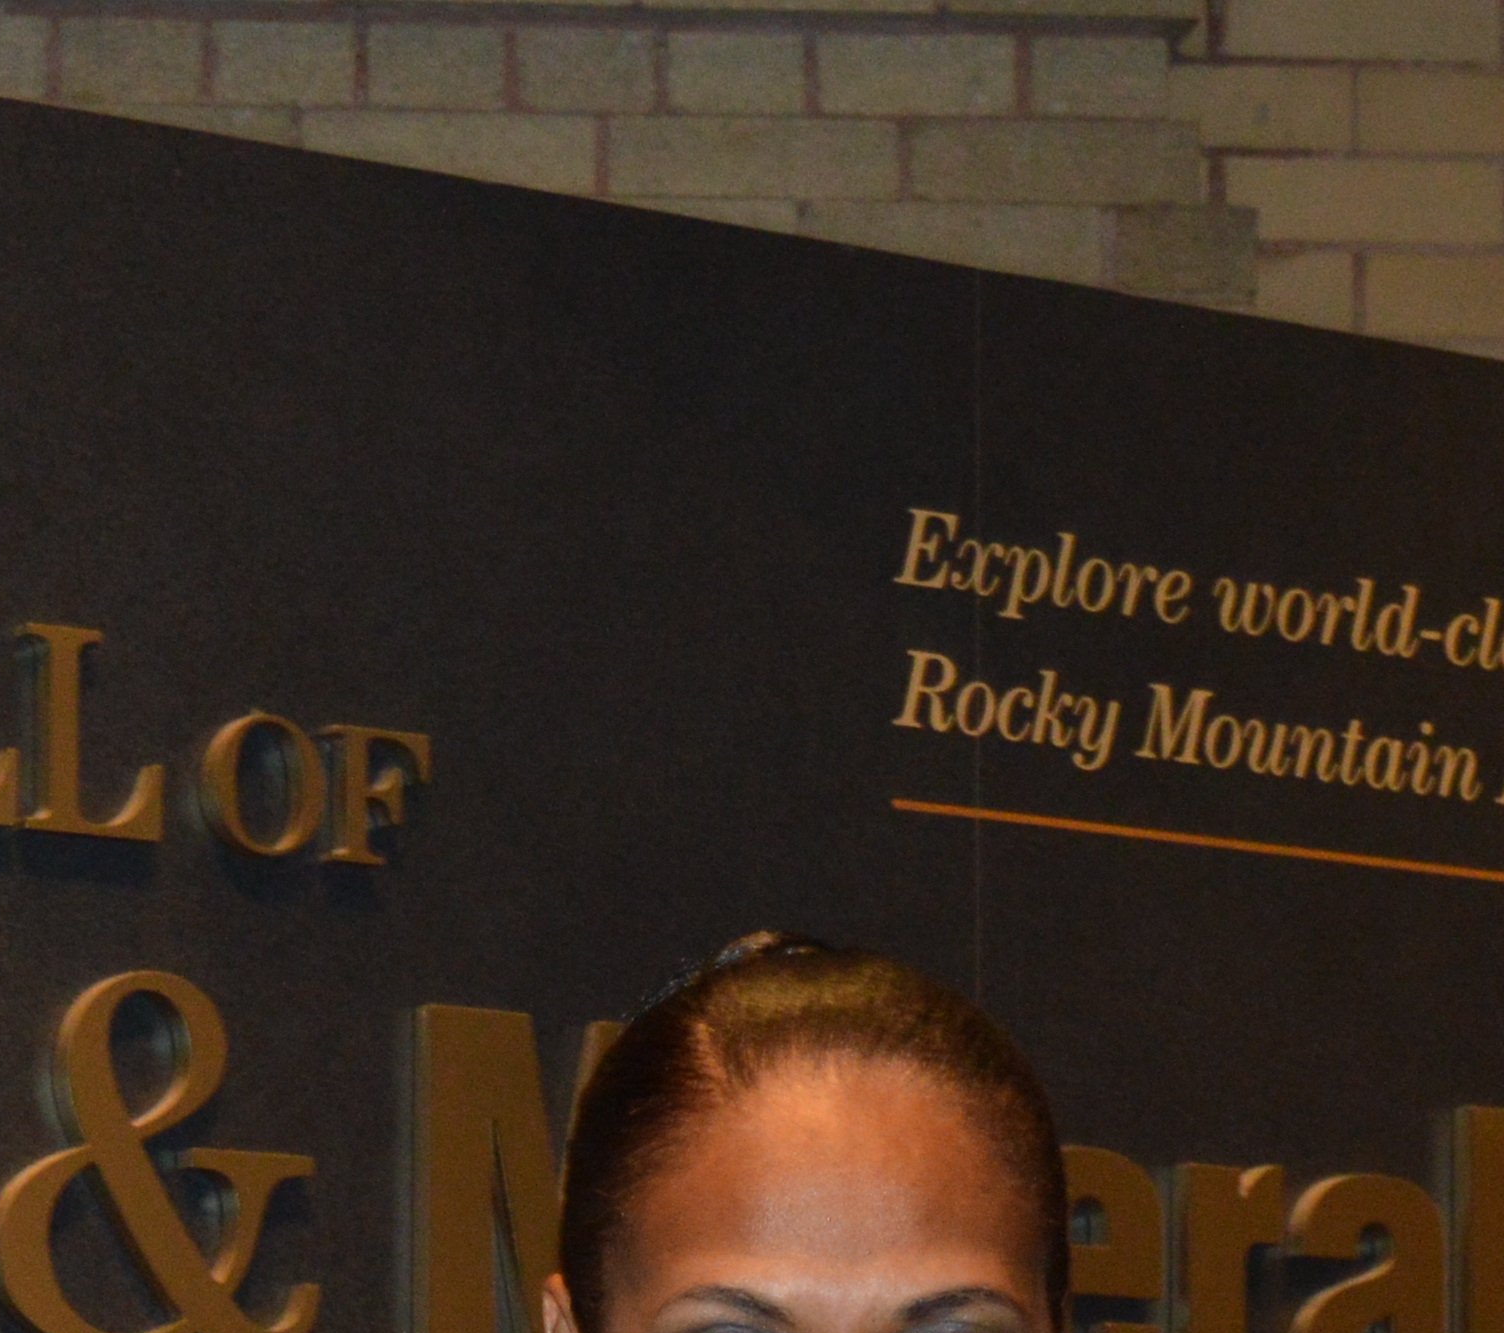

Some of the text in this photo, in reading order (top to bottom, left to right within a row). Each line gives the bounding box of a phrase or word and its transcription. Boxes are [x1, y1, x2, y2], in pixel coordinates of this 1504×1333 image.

[895, 508, 1194, 625] Explore
[194, 707, 432, 865] OF
[893, 649, 1121, 772] Rocky
[1136, 683, 1482, 802] Mountain
